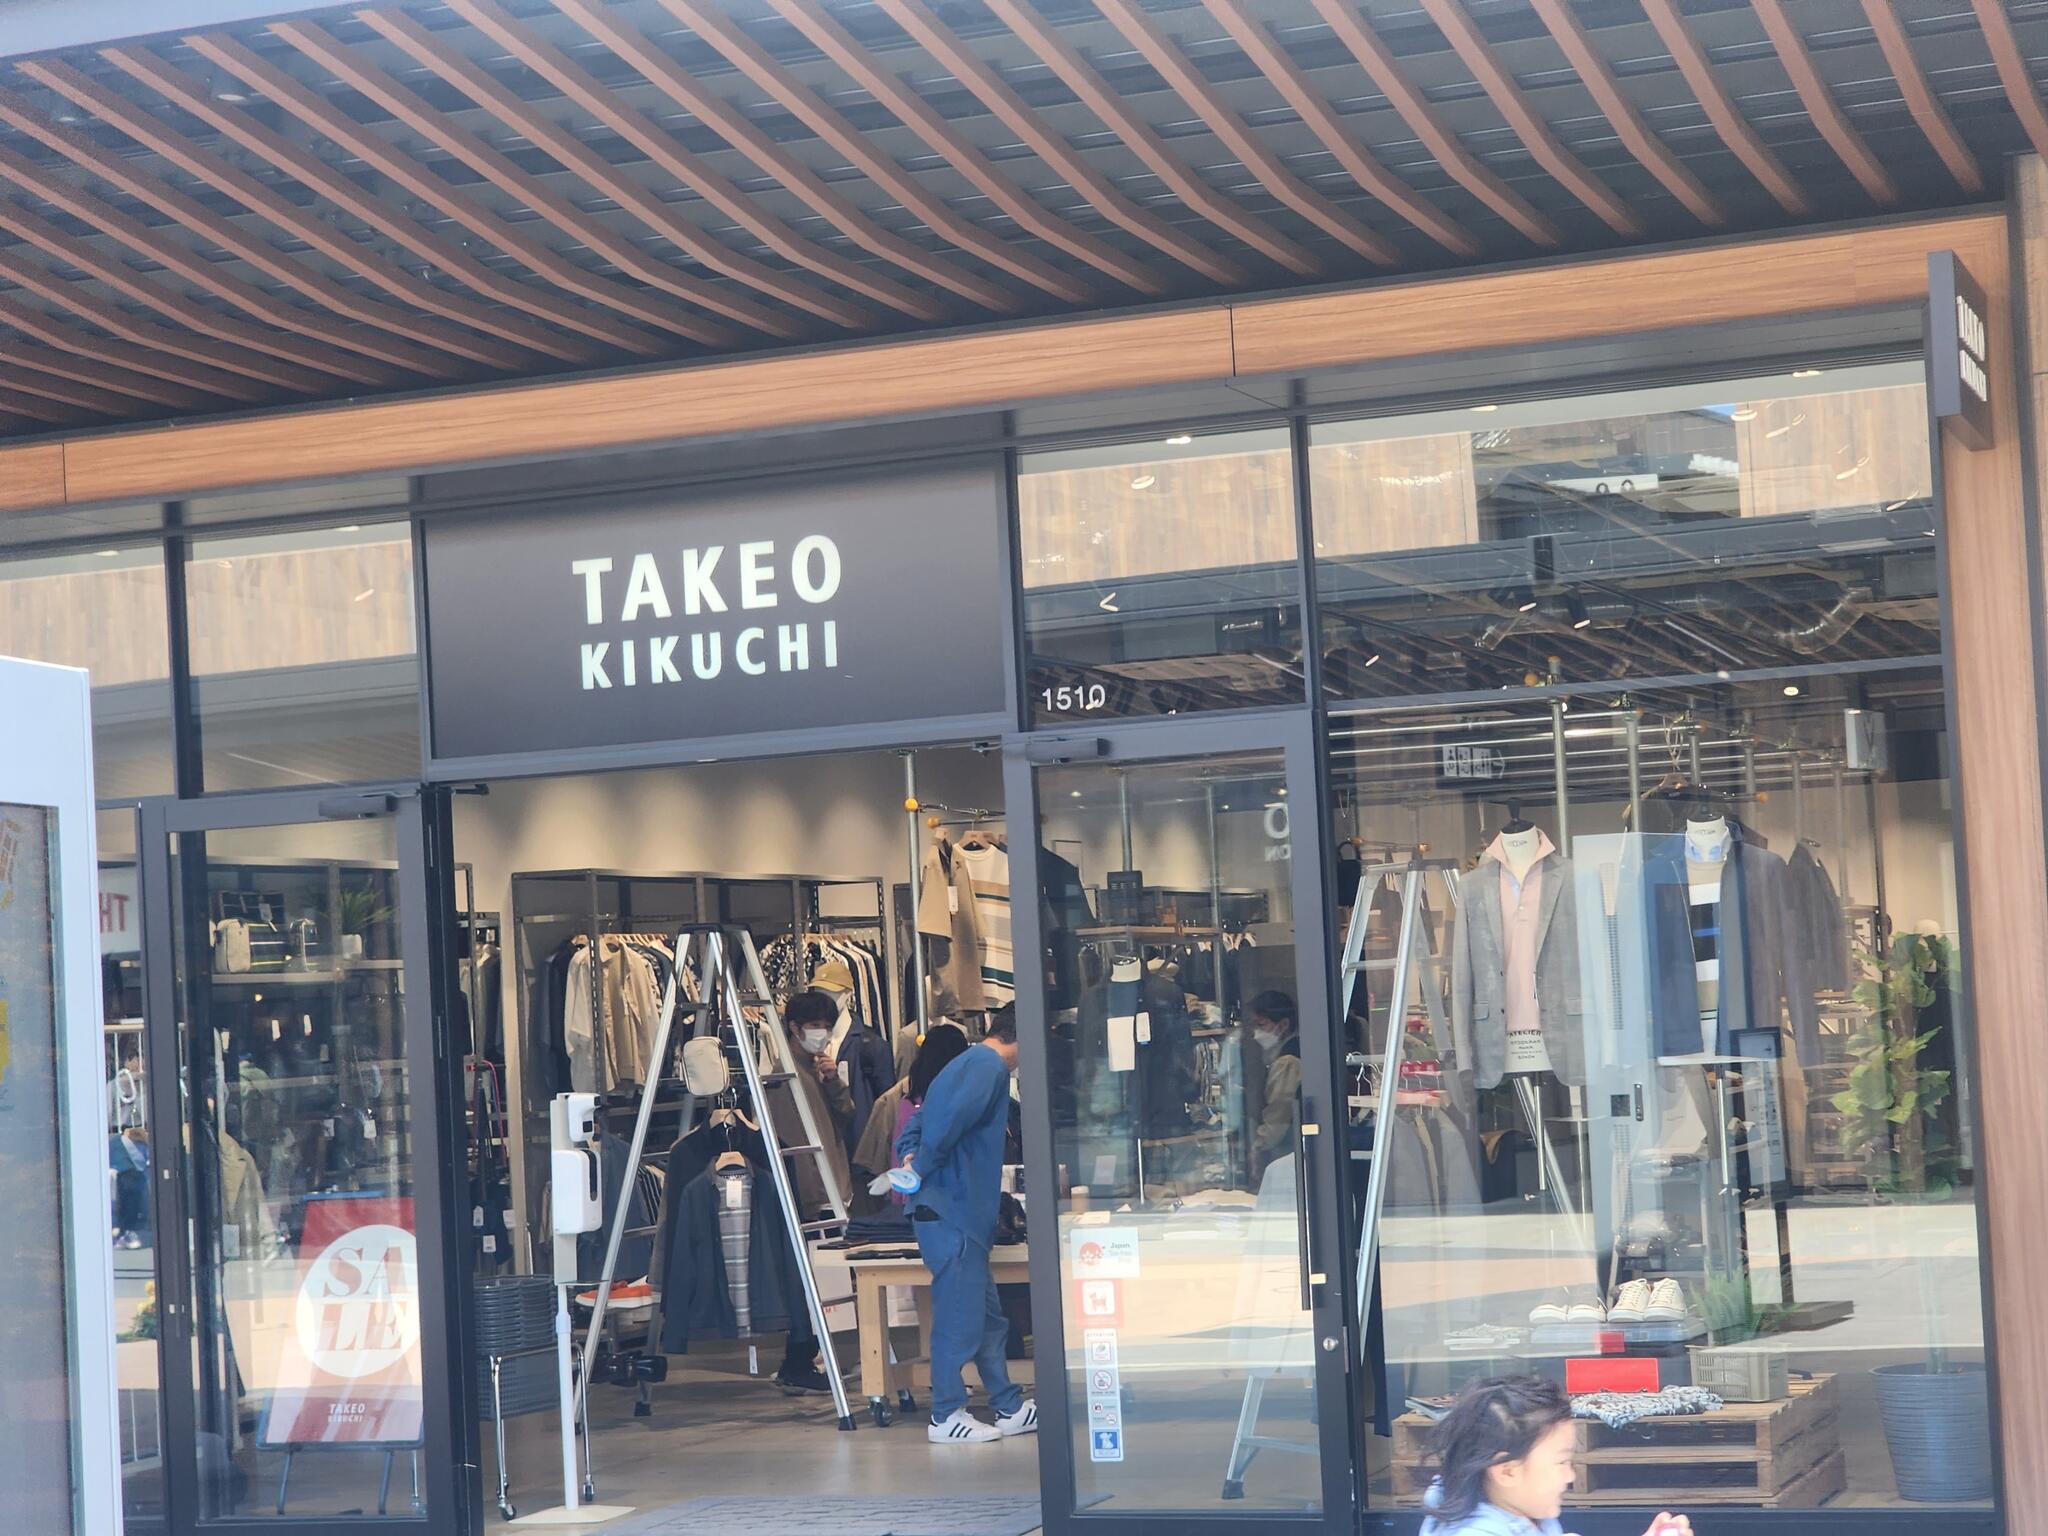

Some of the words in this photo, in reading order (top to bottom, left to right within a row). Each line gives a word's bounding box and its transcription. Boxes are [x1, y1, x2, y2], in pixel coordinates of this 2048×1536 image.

[572, 534, 842, 625] TAKEO
[580, 620, 838, 690] KIKUCHI
[1042, 684, 1106, 711] 1510
[329, 1403, 366, 1414] TAKEO
